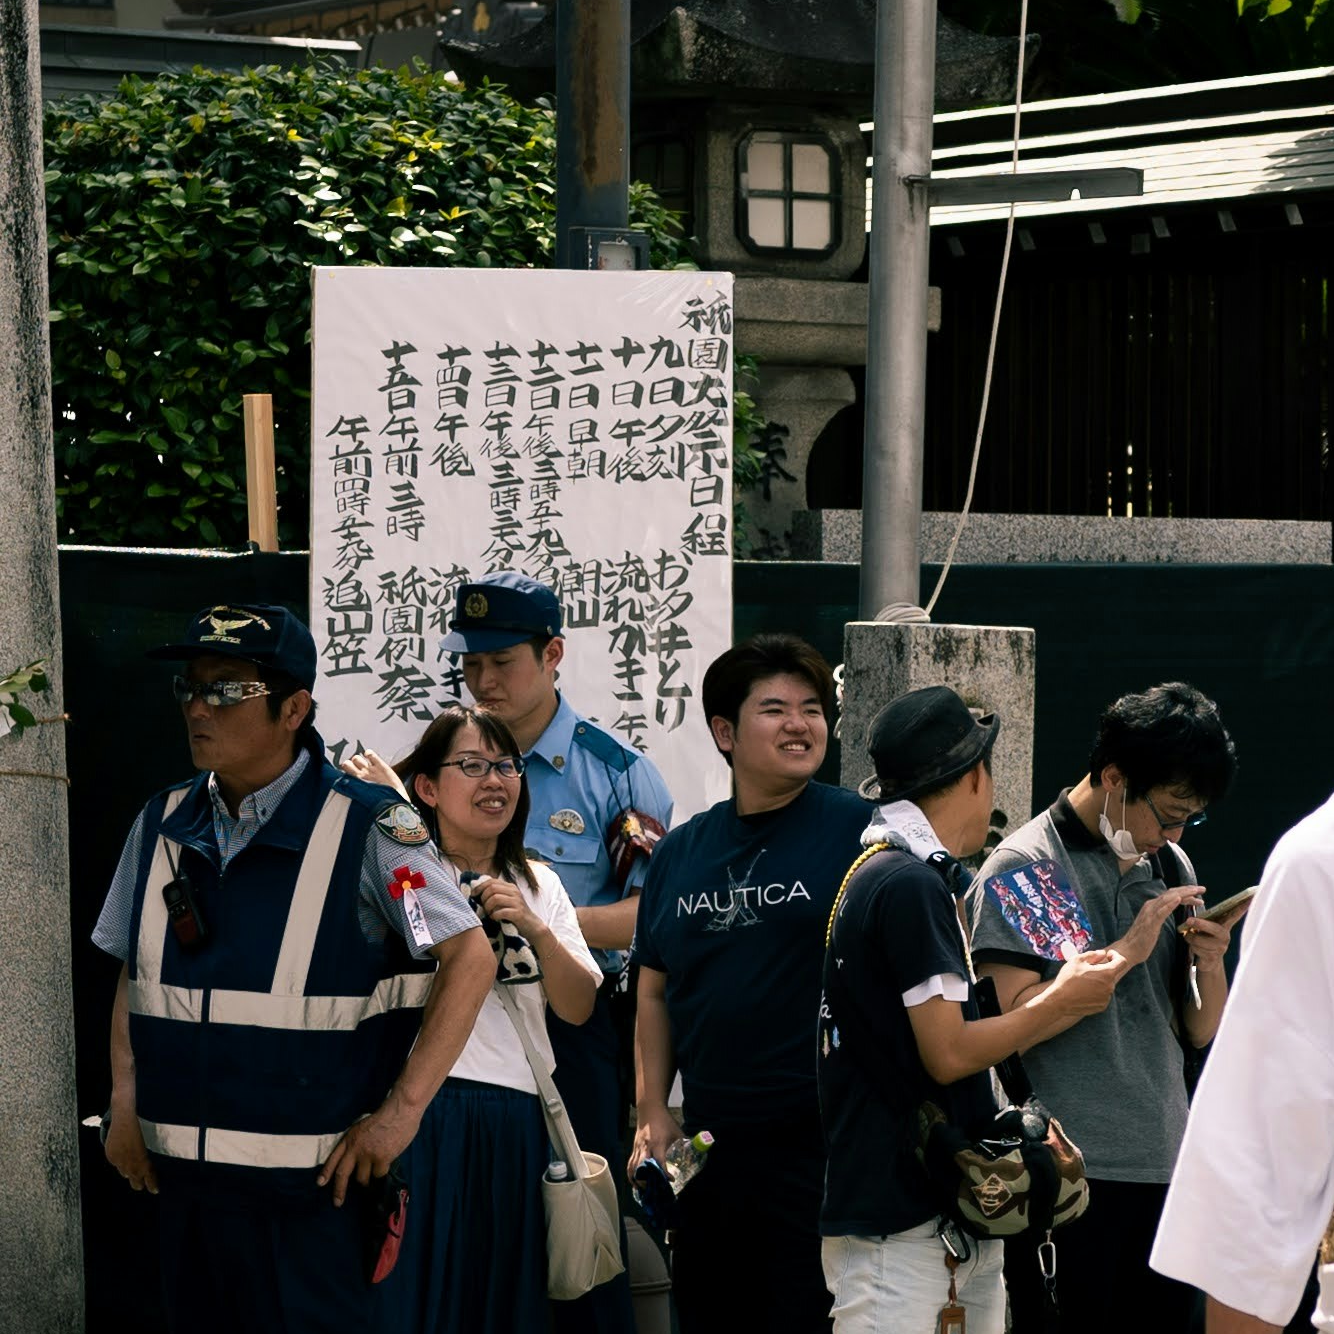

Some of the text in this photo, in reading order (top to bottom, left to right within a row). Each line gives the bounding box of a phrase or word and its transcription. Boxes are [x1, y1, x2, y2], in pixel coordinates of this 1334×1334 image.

[429, 343, 476, 477] 十四日午後
[372, 339, 437, 724] 十五日午前三時 祇園例祭
[321, 570, 374, 678] 追山笠
[646, 548, 693, 733] お汐井とり
[677, 880, 812, 917] NAUTICA
